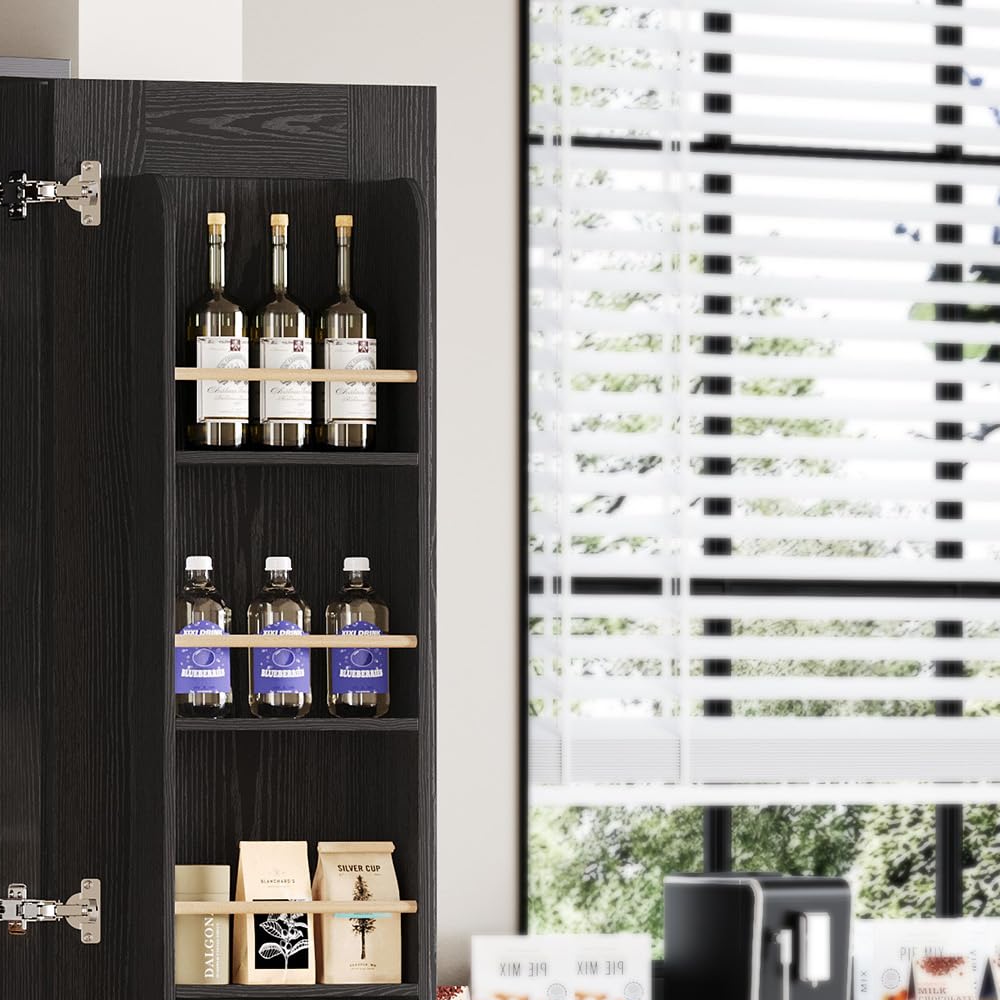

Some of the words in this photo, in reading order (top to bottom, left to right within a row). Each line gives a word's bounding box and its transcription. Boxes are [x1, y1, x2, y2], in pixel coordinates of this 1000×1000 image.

[337, 864, 364, 872] SILVER
[365, 864, 381, 872] CUP
[204, 914, 214, 977] DALGON
